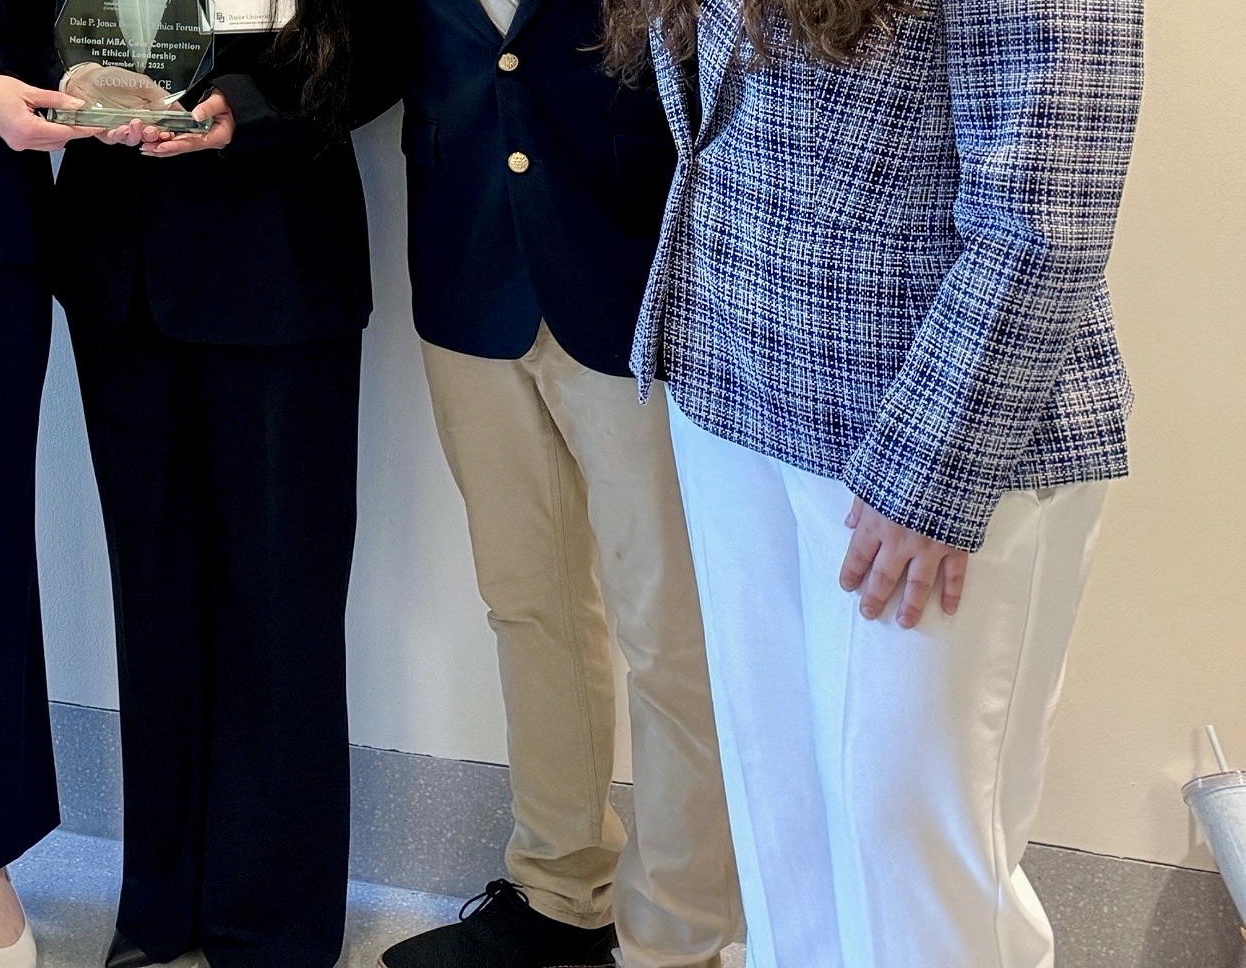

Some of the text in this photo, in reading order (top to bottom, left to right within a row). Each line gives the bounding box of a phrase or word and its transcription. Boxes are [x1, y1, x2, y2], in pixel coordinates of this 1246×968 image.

[69, 18, 87, 26] Dale
[88, 19, 96, 27] P.
[96, 19, 117, 28] Jones
[175, 23, 201, 32] Forum
[69, 36, 104, 45] National
[106, 38, 126, 46] MBA
[151, 40, 201, 51] Competition
[102, 49, 130, 58] Ethical
[132, 50, 177, 62] Leadership
[102, 60, 134, 68] November
[148, 61, 165, 69] 2025
[95, 76, 172, 90] SECOND PLACE
